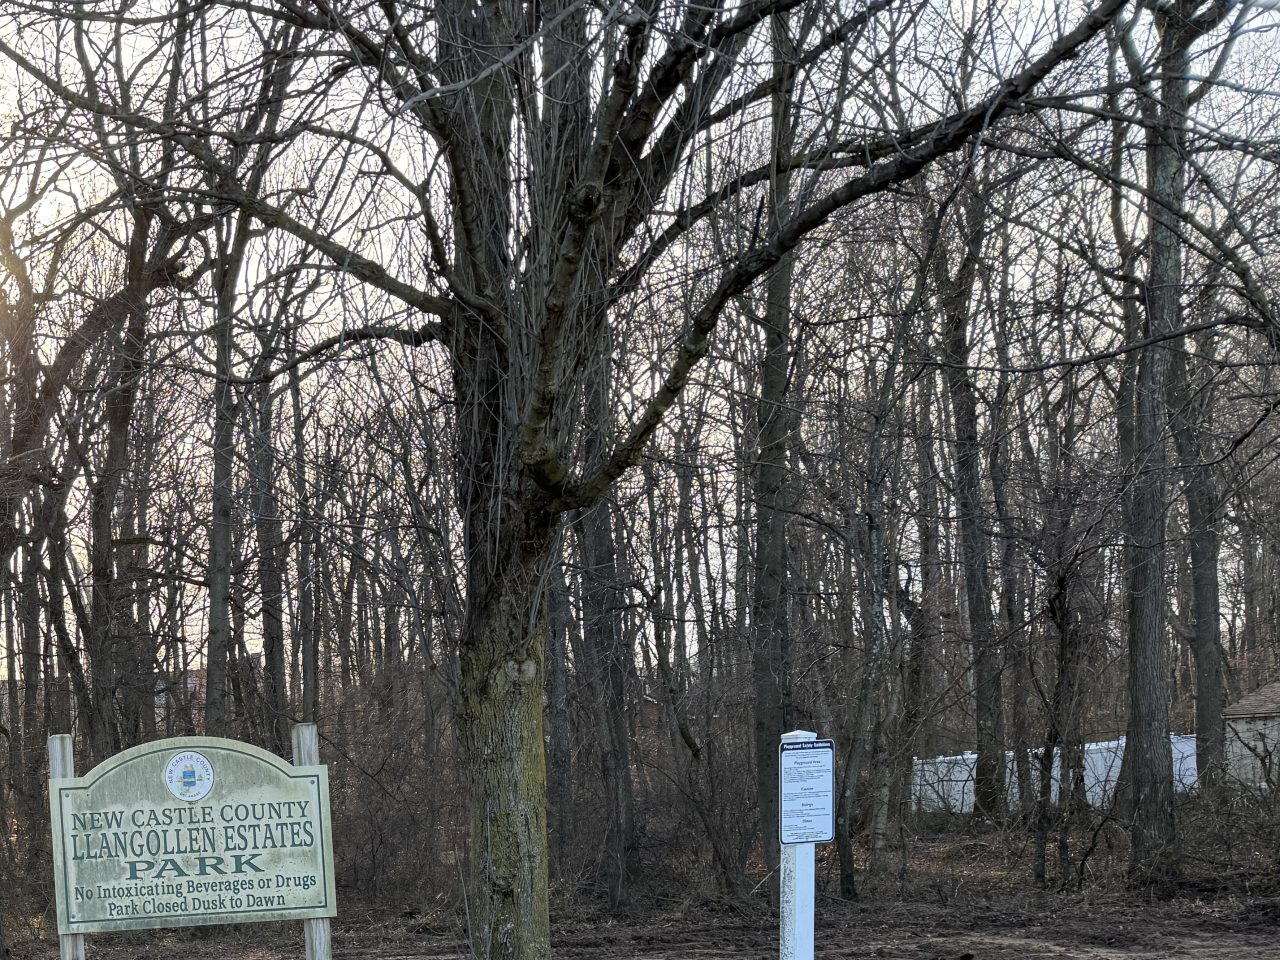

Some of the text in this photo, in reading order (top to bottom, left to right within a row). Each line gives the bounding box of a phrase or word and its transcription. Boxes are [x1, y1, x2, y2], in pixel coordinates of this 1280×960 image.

[172, 755, 193, 767] CASTLE
[196, 757, 211, 781] COUNTY
[71, 801, 310, 830] NEW CASTLE COUNTY
[71, 820, 314, 860] LLANGOLLEN ESTATES
[124, 853, 265, 880] PARK
[74, 874, 316, 900] No Intoxicating Beverages or Drugs
[108, 894, 285, 916] Park Closed Dusk to Dawn
